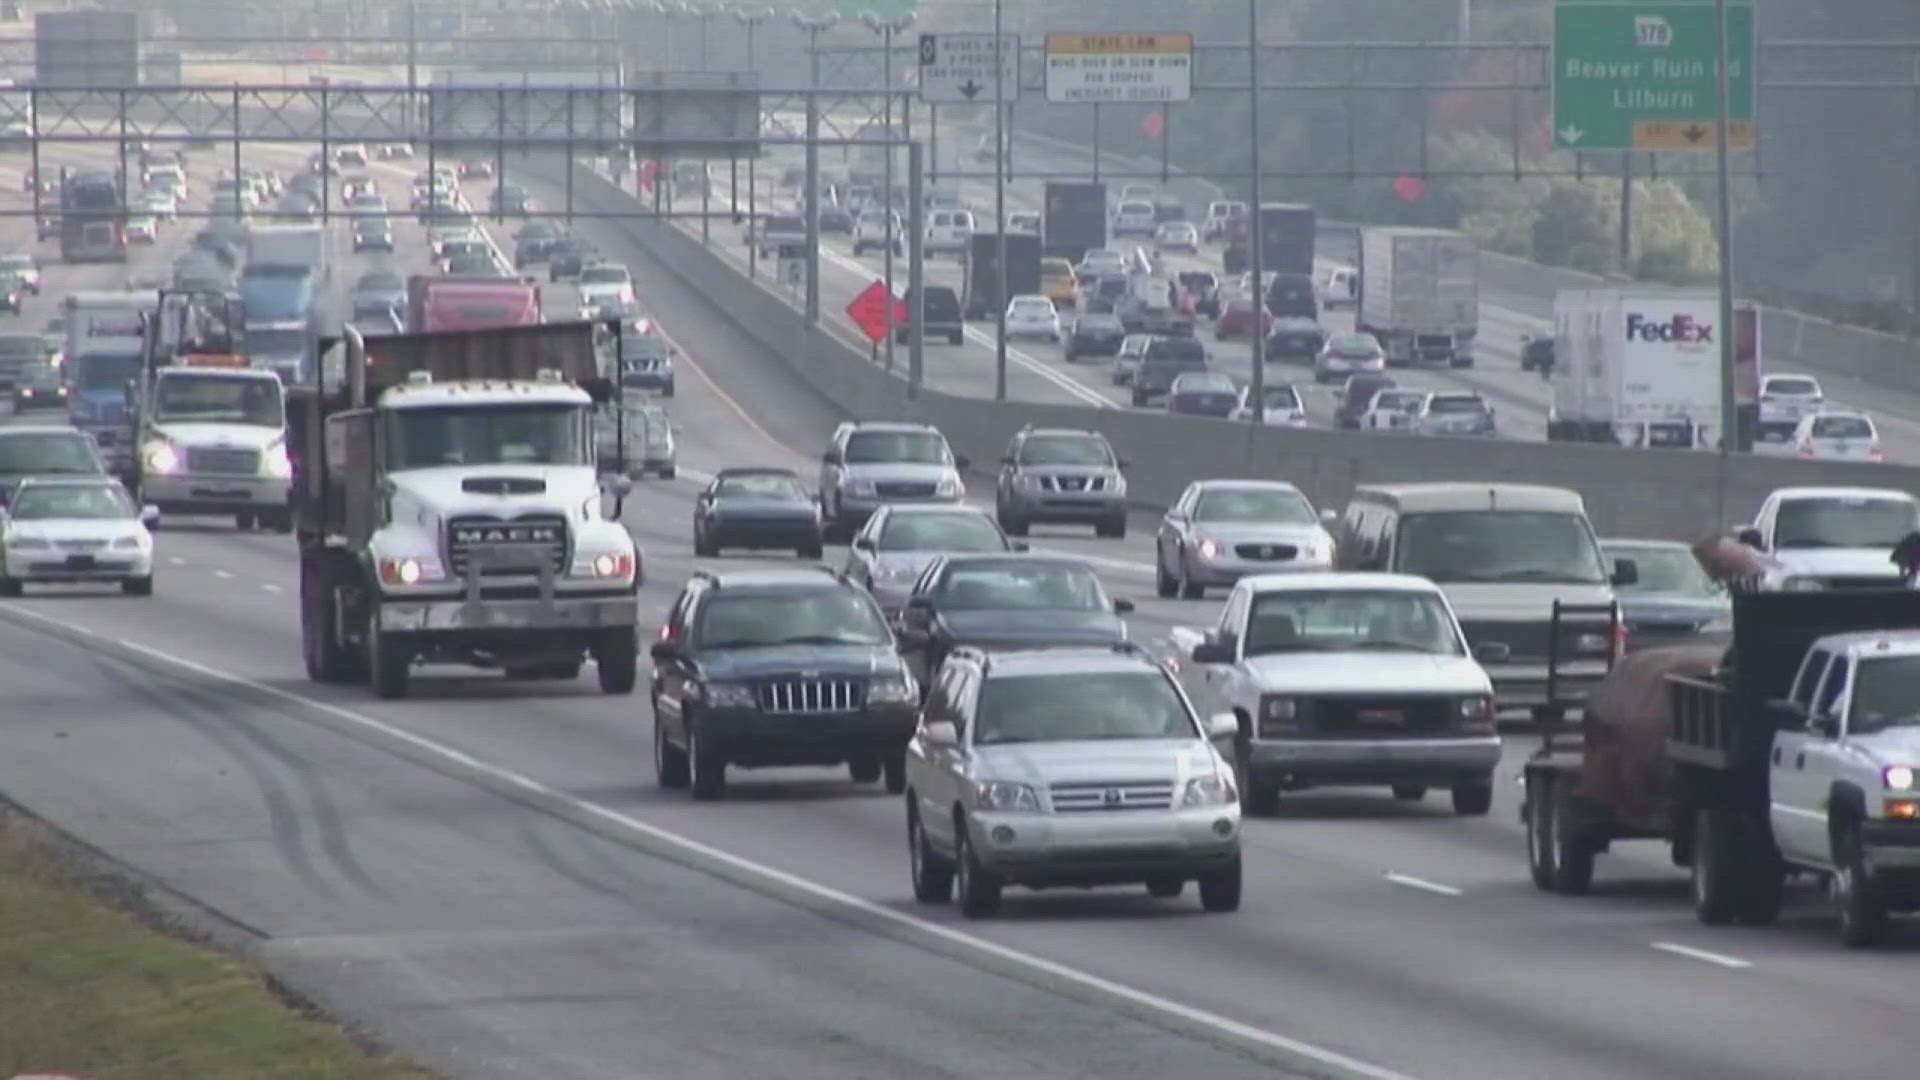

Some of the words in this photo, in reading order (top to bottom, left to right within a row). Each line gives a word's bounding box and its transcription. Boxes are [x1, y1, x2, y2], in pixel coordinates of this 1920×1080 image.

[1566, 57, 1640, 78] Beaver
[1652, 57, 1704, 78] Ruin
[1613, 88, 1694, 109] Lilburn
[1626, 313, 1712, 342] FedEx
[457, 529, 555, 542] MACK
